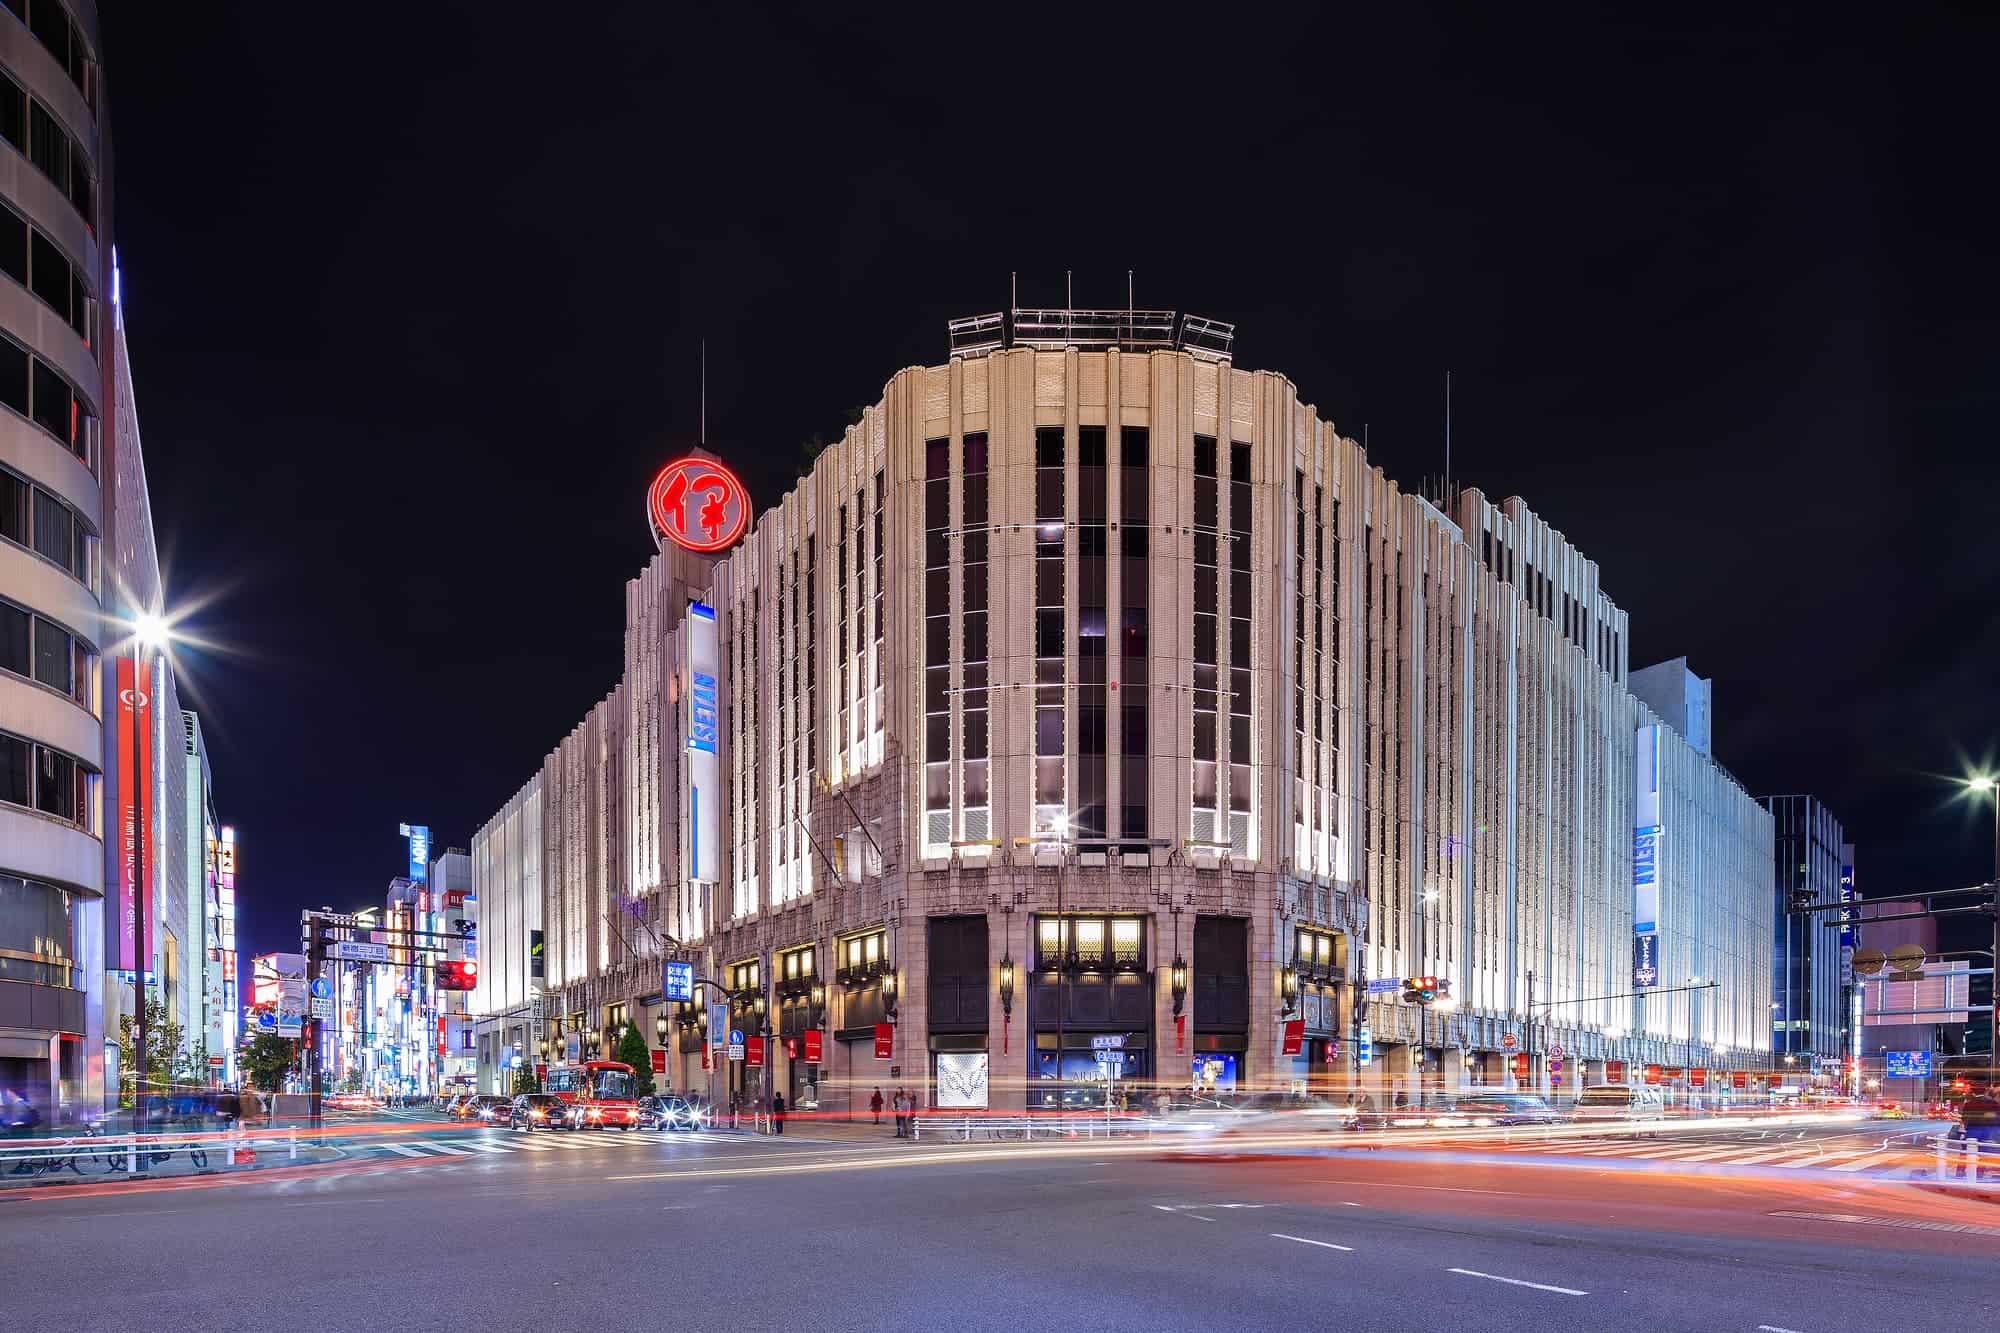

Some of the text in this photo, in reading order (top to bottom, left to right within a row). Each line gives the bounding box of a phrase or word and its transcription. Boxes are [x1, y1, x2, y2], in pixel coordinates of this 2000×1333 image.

[412, 834, 428, 865] AOKI
[1841, 876, 1851, 884] 3
[1840, 889, 1851, 909] ITY
